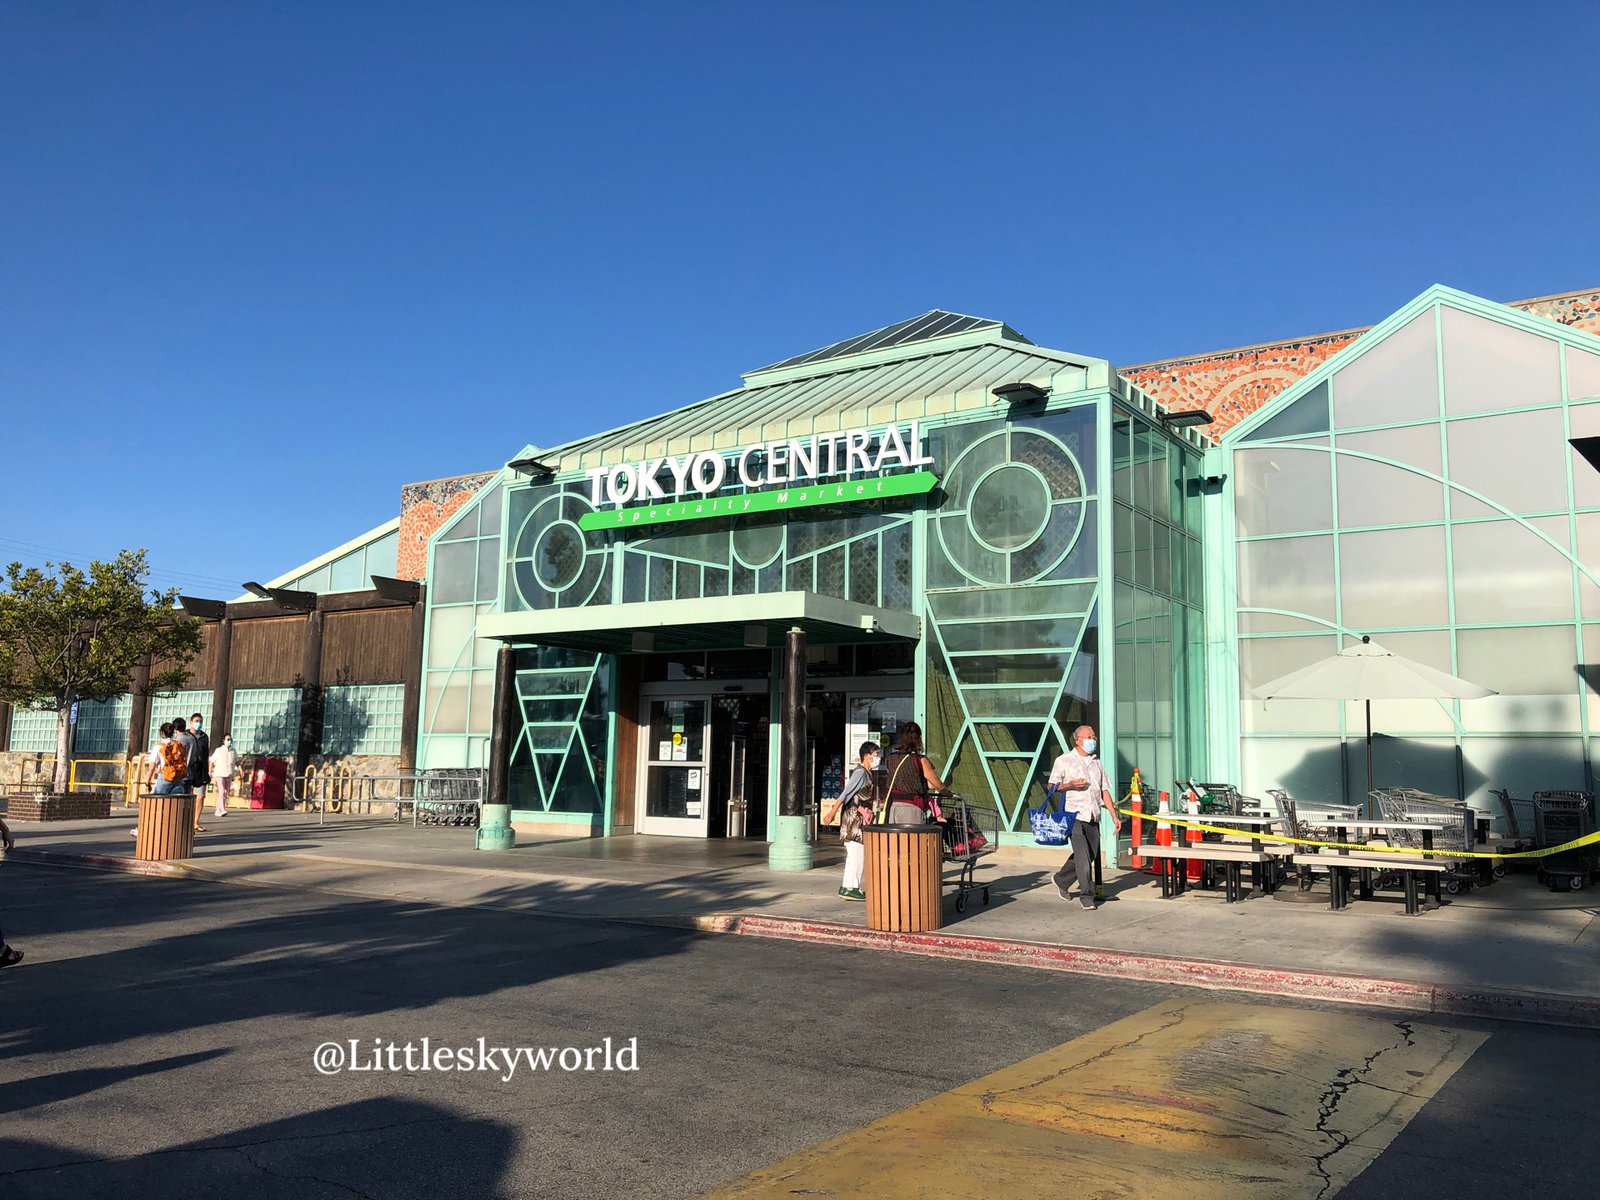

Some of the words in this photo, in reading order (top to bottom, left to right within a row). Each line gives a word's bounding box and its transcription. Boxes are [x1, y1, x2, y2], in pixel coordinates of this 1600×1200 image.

[585, 451, 726, 507] TOKYO
[738, 420, 935, 488] CENTRAL
[617, 498, 751, 523] Specialty
[777, 482, 882, 504] Market
